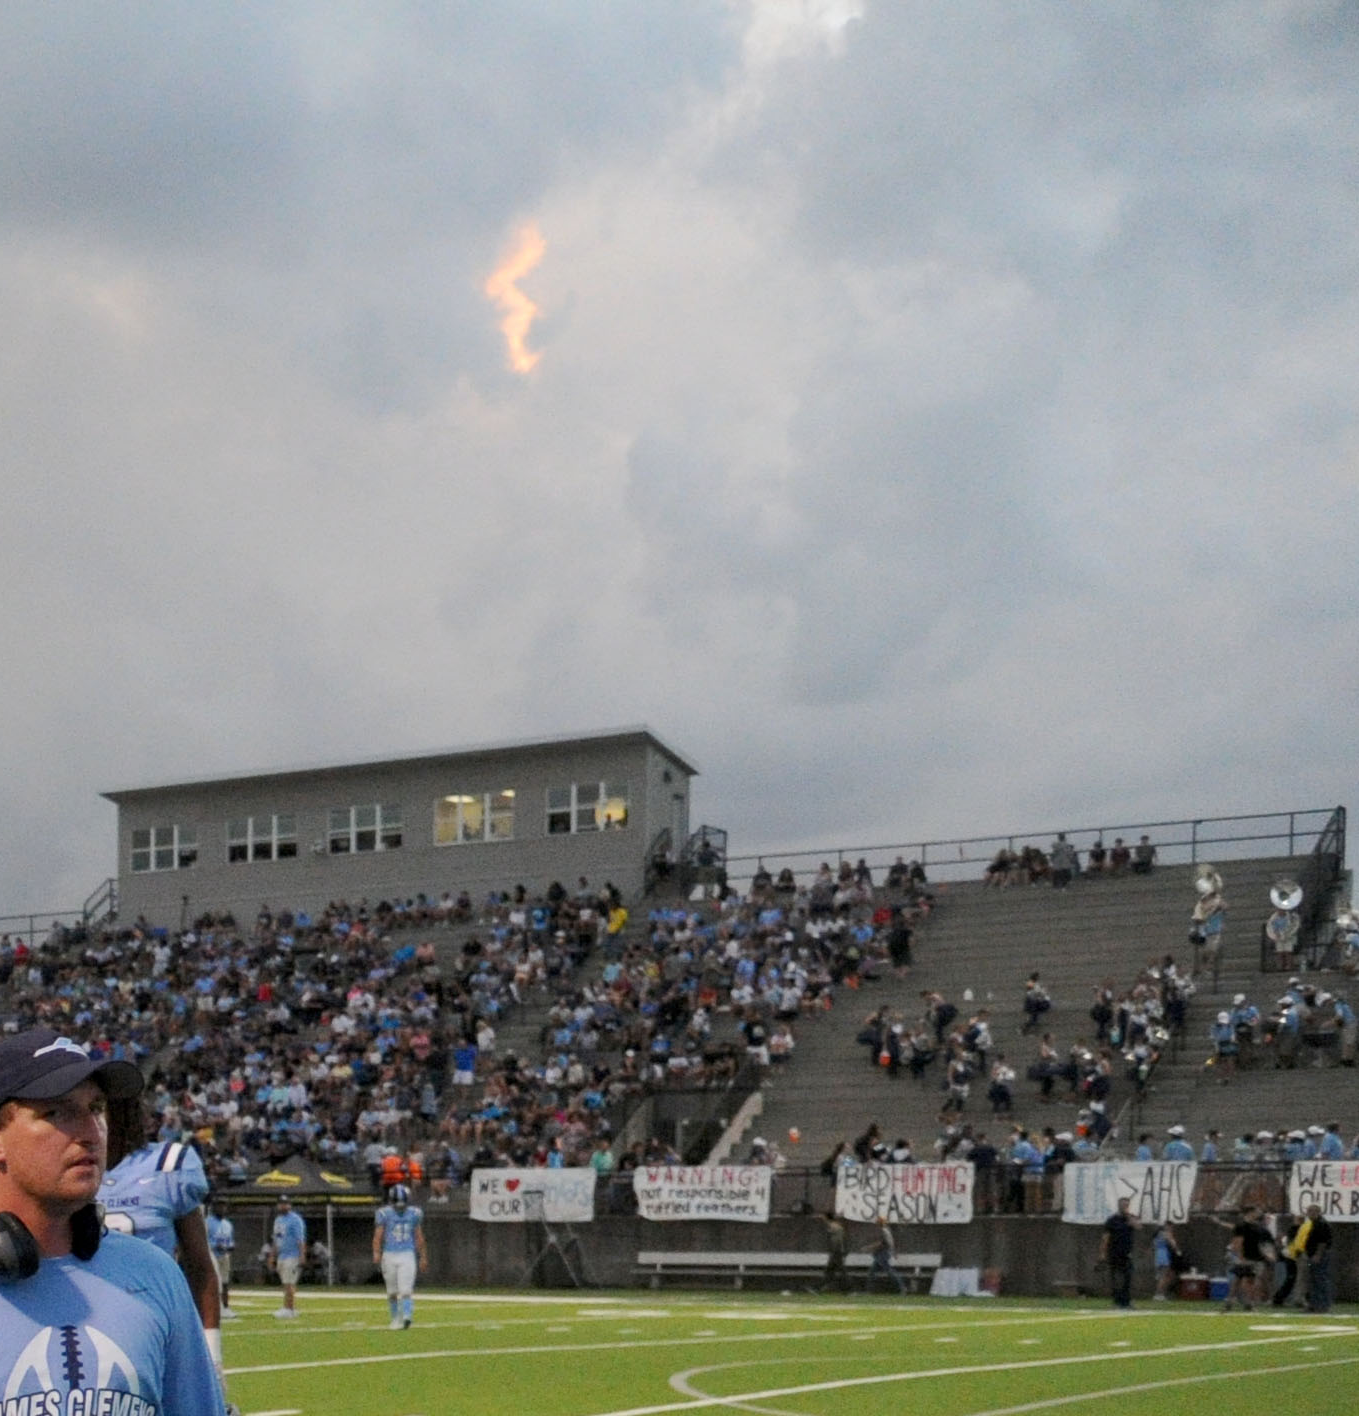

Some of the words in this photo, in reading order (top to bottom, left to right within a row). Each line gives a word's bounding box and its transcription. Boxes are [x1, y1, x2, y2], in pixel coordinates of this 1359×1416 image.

[479, 1179, 500, 1195] WE
[844, 1166, 890, 1191] BIRD
[891, 1166, 968, 1195] HUNTING
[1297, 1164, 1333, 1188] WE
[641, 1187, 662, 1200] not
[668, 1187, 751, 1202] responsible
[1139, 1164, 1191, 1220] AHS
[1299, 1190, 1344, 1216] OUR
[489, 1199, 521, 1217] OUR
[861, 1193, 939, 1221] SEASON
